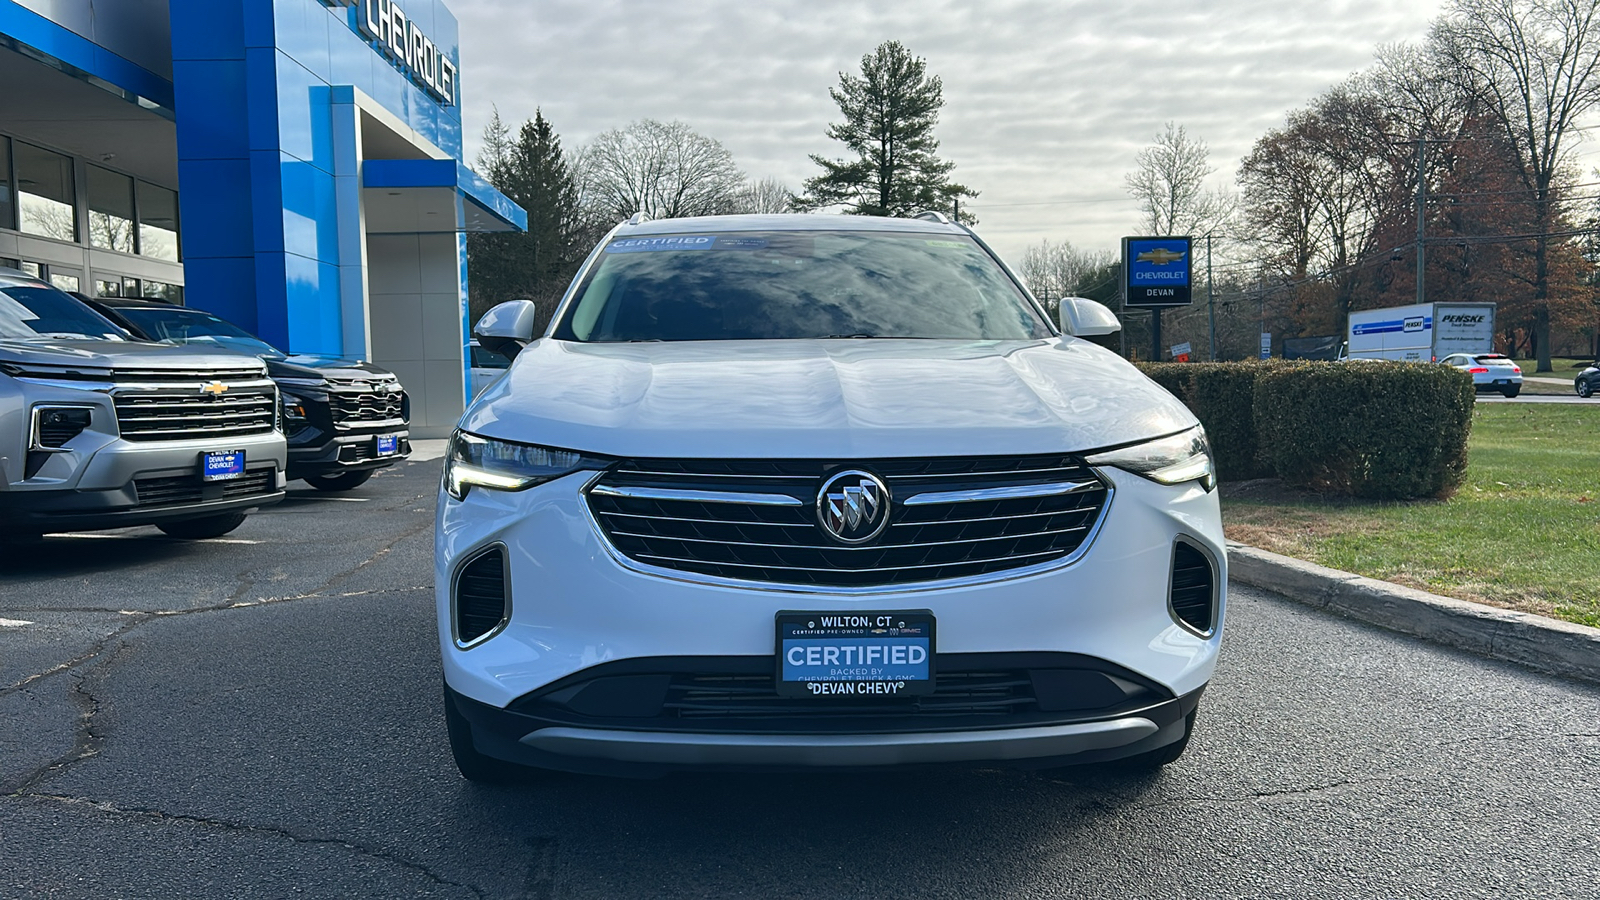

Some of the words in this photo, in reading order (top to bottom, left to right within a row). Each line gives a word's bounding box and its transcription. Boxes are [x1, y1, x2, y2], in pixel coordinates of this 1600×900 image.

[366, 0, 456, 107] CHEVROLET
[612, 237, 709, 248] CERTIFIED
[1135, 271, 1185, 280] CHEVROLET
[1146, 288, 1174, 297] DEVAN
[1441, 313, 1486, 323] PENSKE
[208, 461, 234, 469] CHEVROLET
[820, 616, 872, 628] WILTON,
[876, 616, 893, 627] CT
[787, 645, 926, 666] CERTIFIED
[830, 668, 868, 676] BACKED
[871, 667, 883, 675] BY
[812, 682, 855, 695] DEVAN
[857, 682, 900, 694] CHEVY
